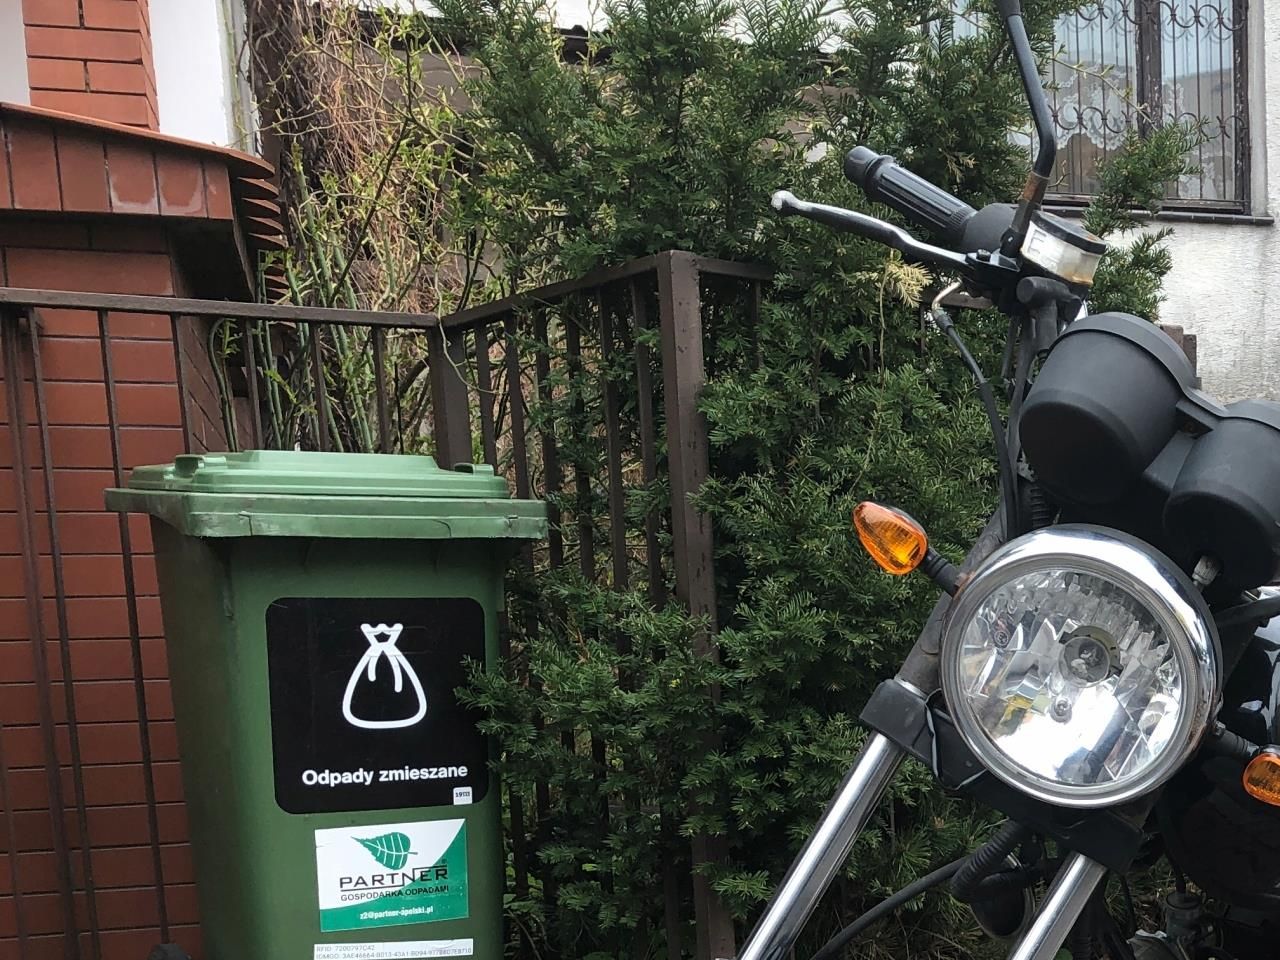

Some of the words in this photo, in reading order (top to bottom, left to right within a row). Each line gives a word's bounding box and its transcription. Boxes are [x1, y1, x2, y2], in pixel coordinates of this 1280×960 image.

[301, 768, 374, 787] Odpady
[378, 765, 468, 782] zmieszane
[340, 868, 448, 886] PARTNER
[340, 890, 403, 902] GOSPODARKA
[405, 885, 449, 896] ODPADAMI
